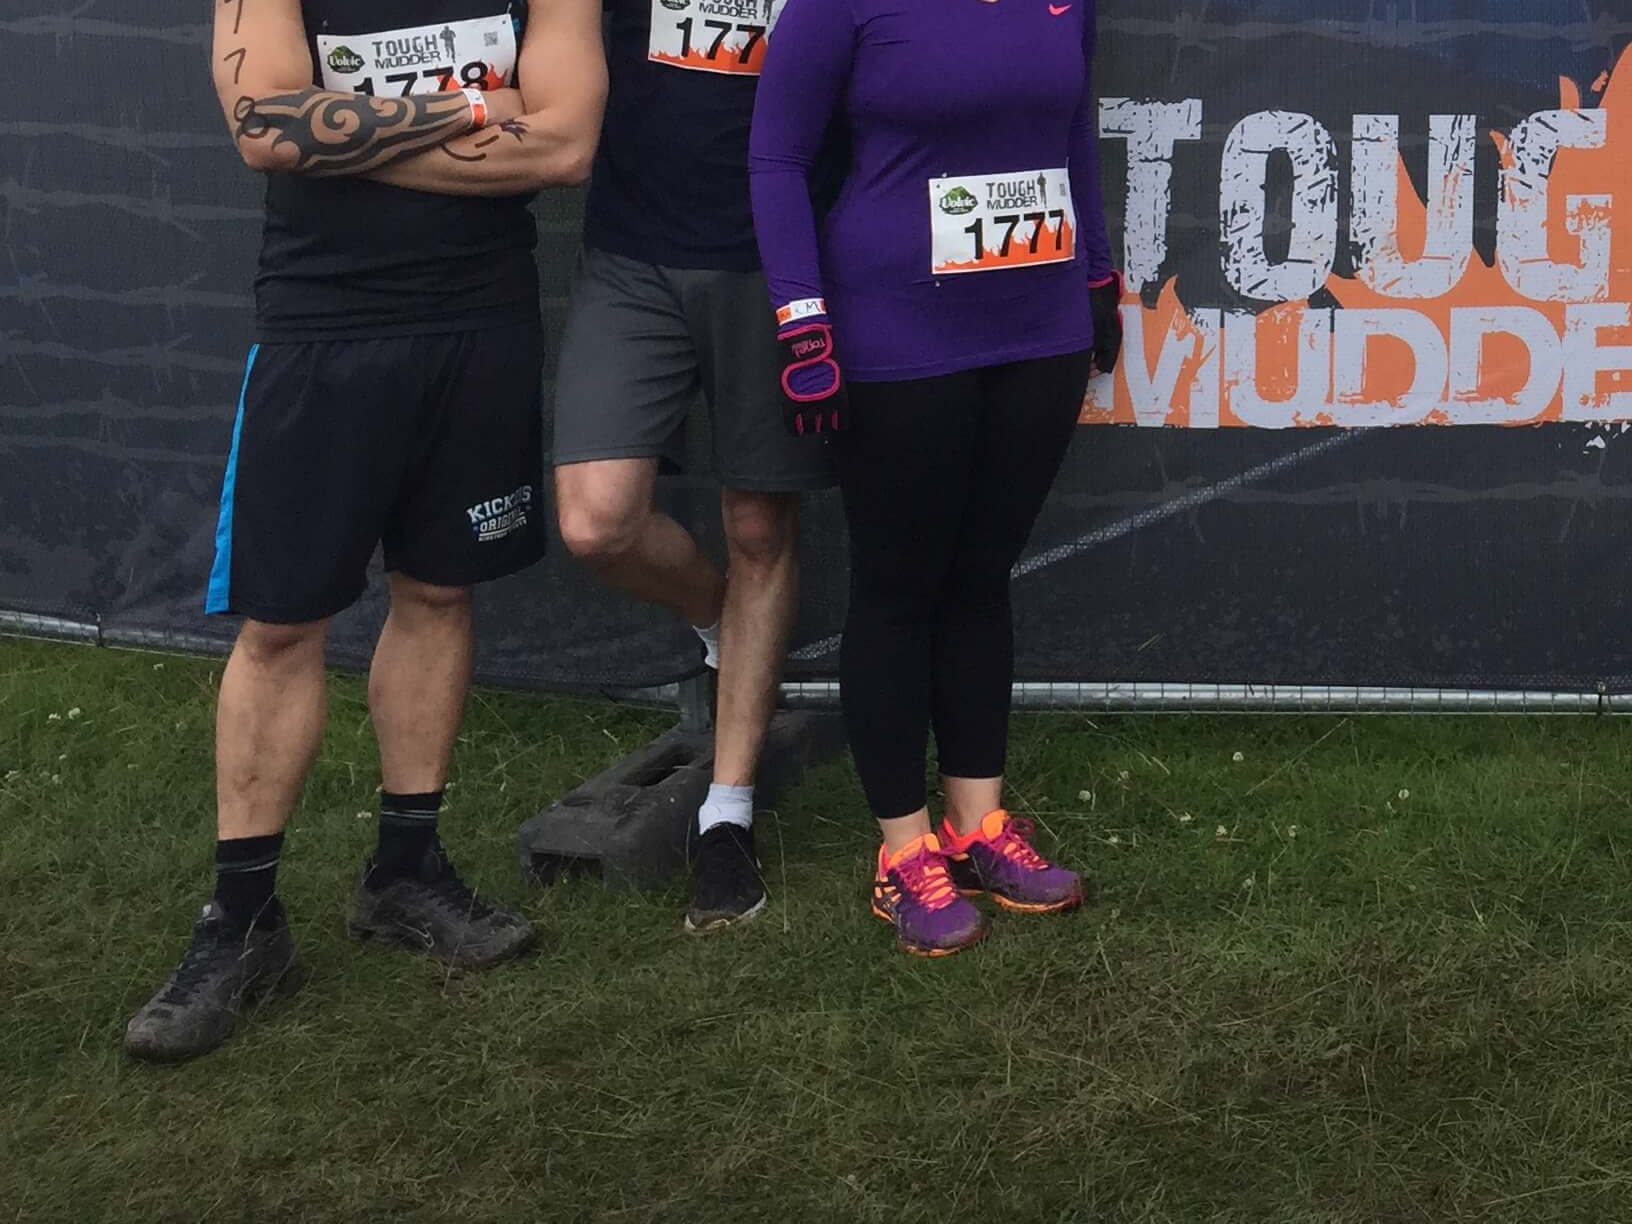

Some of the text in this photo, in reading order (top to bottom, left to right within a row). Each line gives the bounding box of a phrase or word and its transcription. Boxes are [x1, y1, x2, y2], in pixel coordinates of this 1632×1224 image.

[699, 3, 758, 19] MUDDER
[371, 33, 439, 58] TOUGH
[675, 16, 767, 65] 177
[374, 50, 442, 71] MUDDER
[985, 179, 1035, 199] TOUGH
[986, 196, 1038, 211] MUDDER
[963, 208, 1065, 260] 1777
